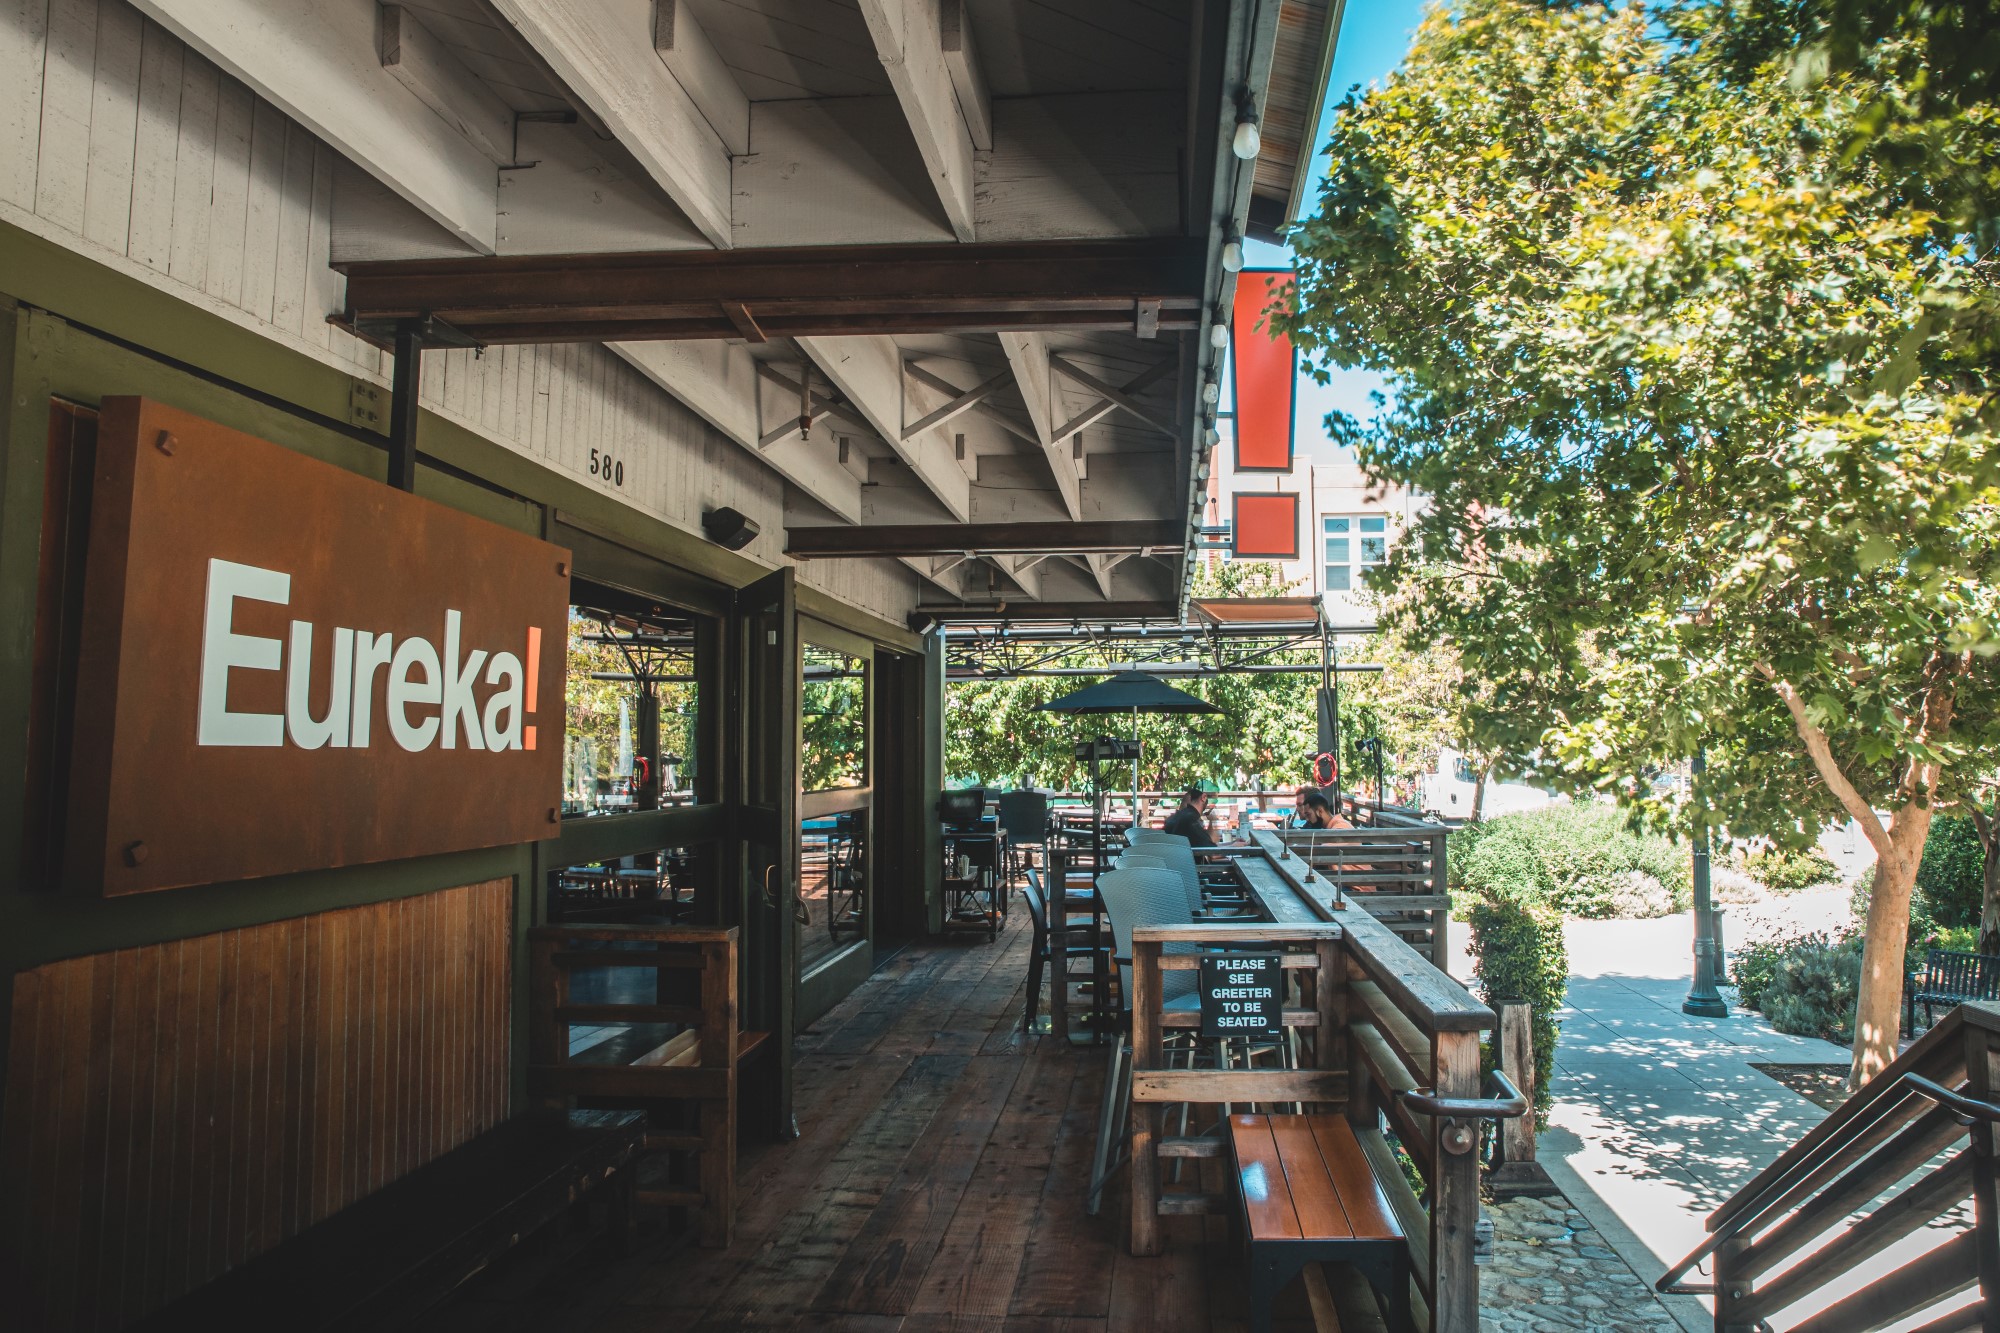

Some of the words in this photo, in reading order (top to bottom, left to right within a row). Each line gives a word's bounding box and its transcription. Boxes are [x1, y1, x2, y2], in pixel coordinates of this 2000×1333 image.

[590, 447, 624, 487] 580
[197, 557, 542, 753] Eureka!
[1216, 959, 1266, 970] PLEASE
[1228, 973, 1254, 984] SEE
[1211, 987, 1272, 999] GREETER
[1222, 1002, 1241, 1013] TO
[1243, 1002, 1262, 1013] BE
[1217, 1016, 1268, 1028] SEATED
